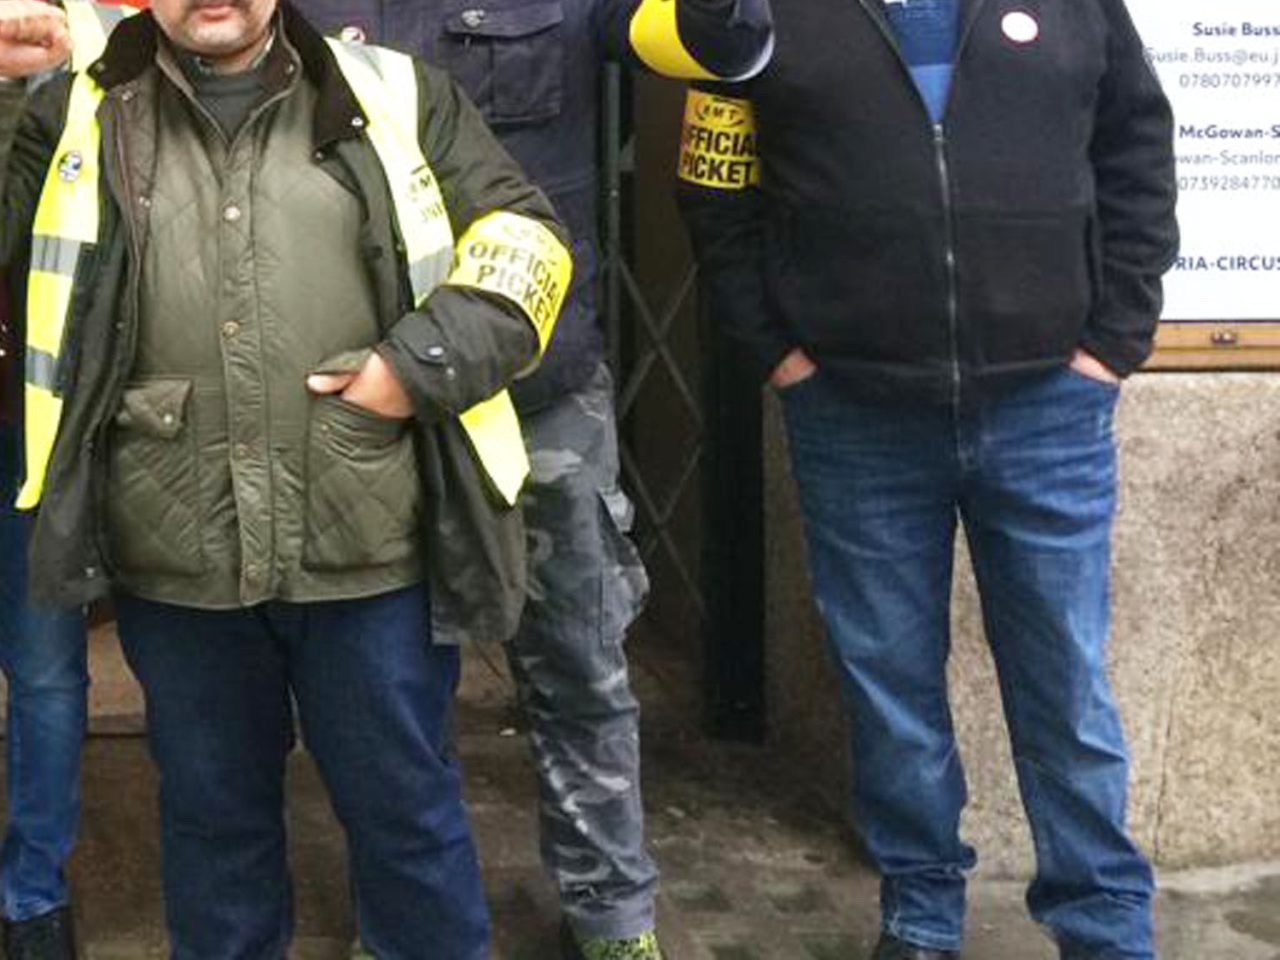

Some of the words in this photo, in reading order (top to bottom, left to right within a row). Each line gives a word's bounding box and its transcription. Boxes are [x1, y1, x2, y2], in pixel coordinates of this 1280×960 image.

[1192, 22, 1237, 36] Susie
[683, 124, 756, 158] FFICIA
[1174, 255, 1280, 271] RIA-CIRCU
